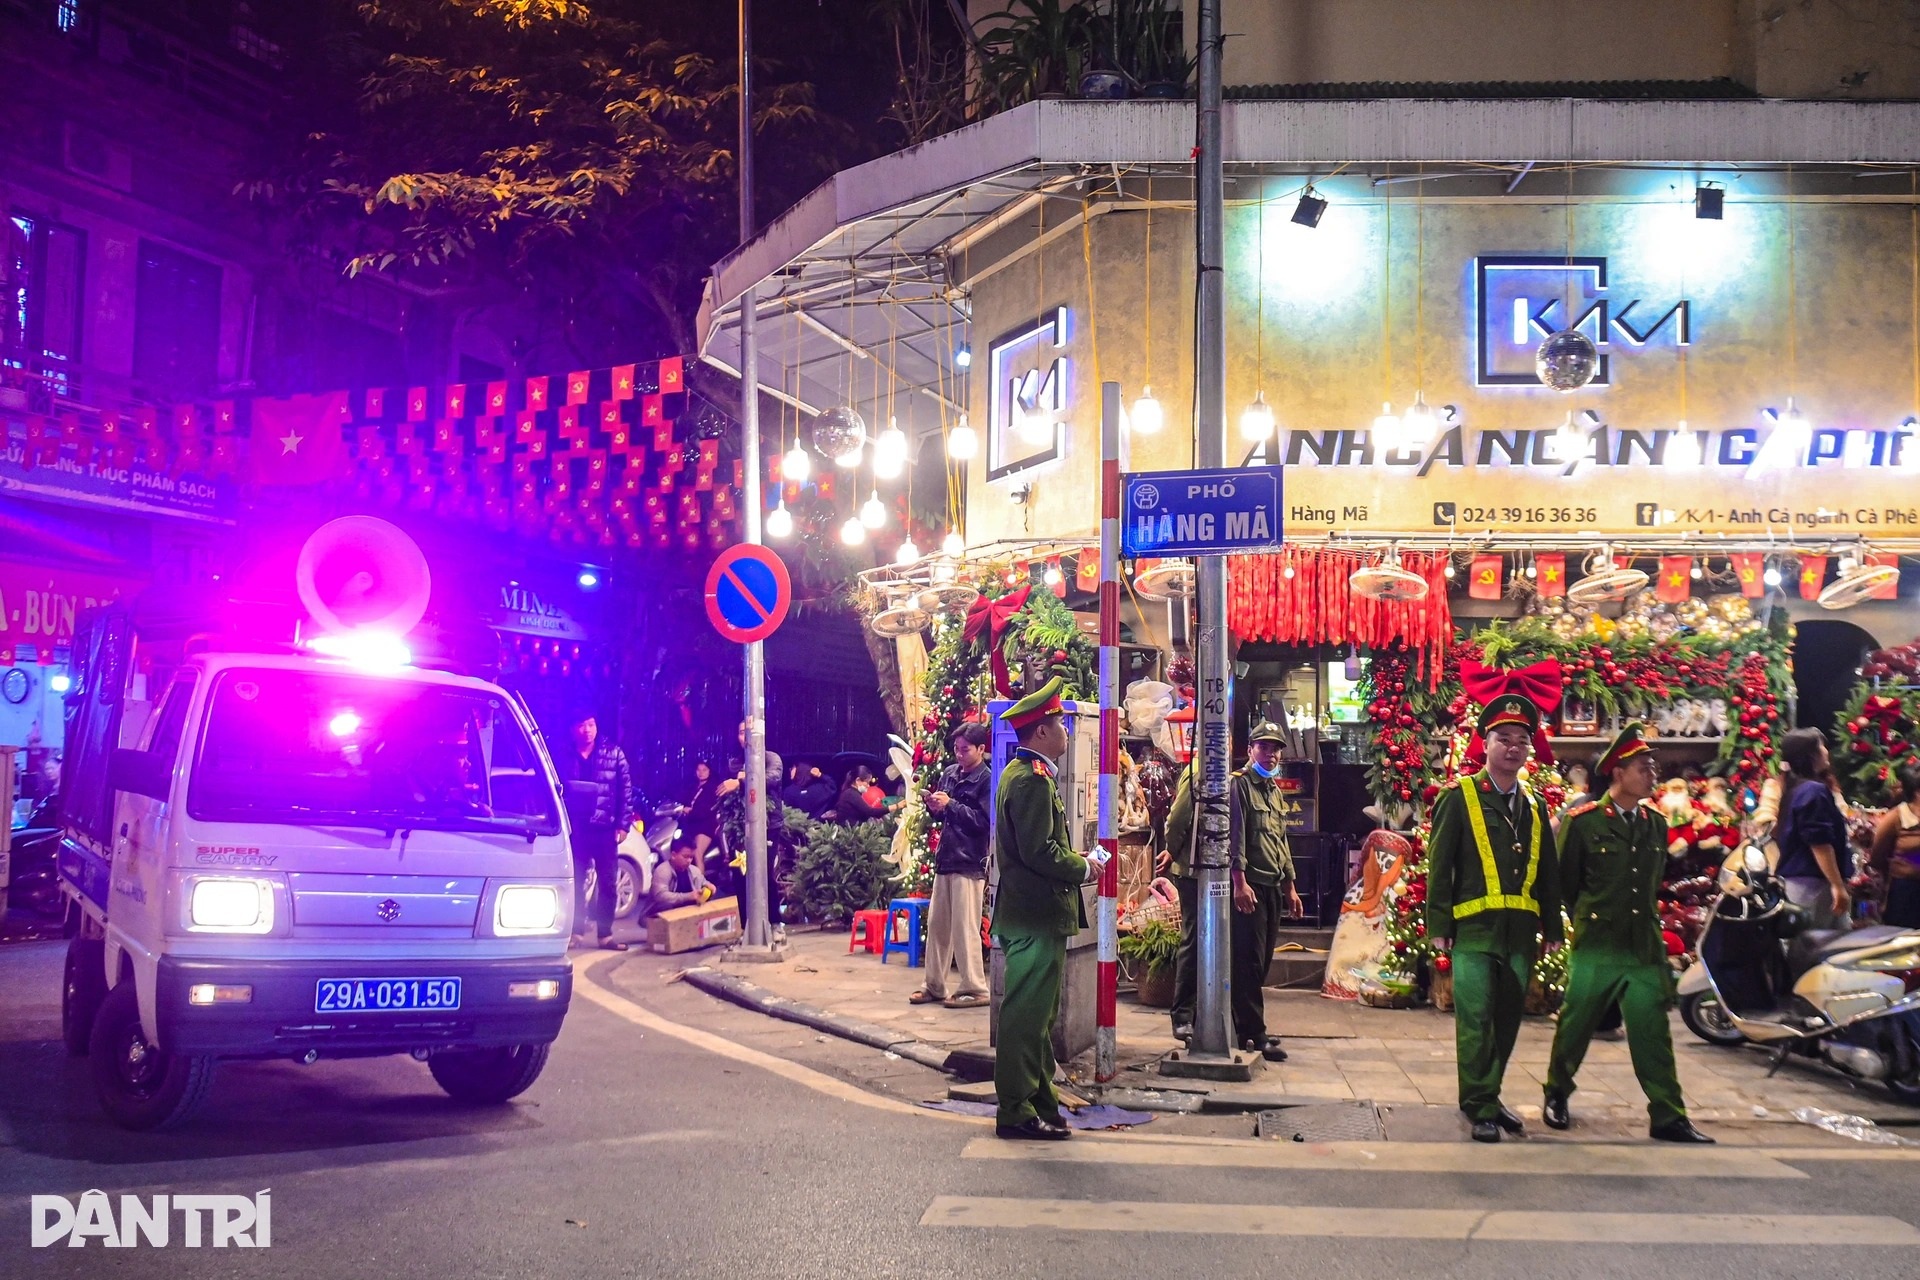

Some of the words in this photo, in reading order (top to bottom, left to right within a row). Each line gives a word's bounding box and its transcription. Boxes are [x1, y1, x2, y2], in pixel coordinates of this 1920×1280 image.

[1187, 477, 1237, 499] PHỐ
[1291, 505, 1336, 524] Hàng
[1343, 505, 1368, 521] Mã
[1728, 508, 1762, 522] Anh
[1856, 508, 1877, 523] Cà
[1885, 509, 1918, 523] Phê
[1138, 507, 1215, 542] HÀNG
[1226, 505, 1270, 540] MÃ
[1205, 678, 1224, 693] TB
[1205, 698, 1225, 715] 40
[197, 846, 260, 855] SUPER
[195, 854, 279, 866] CARRY
